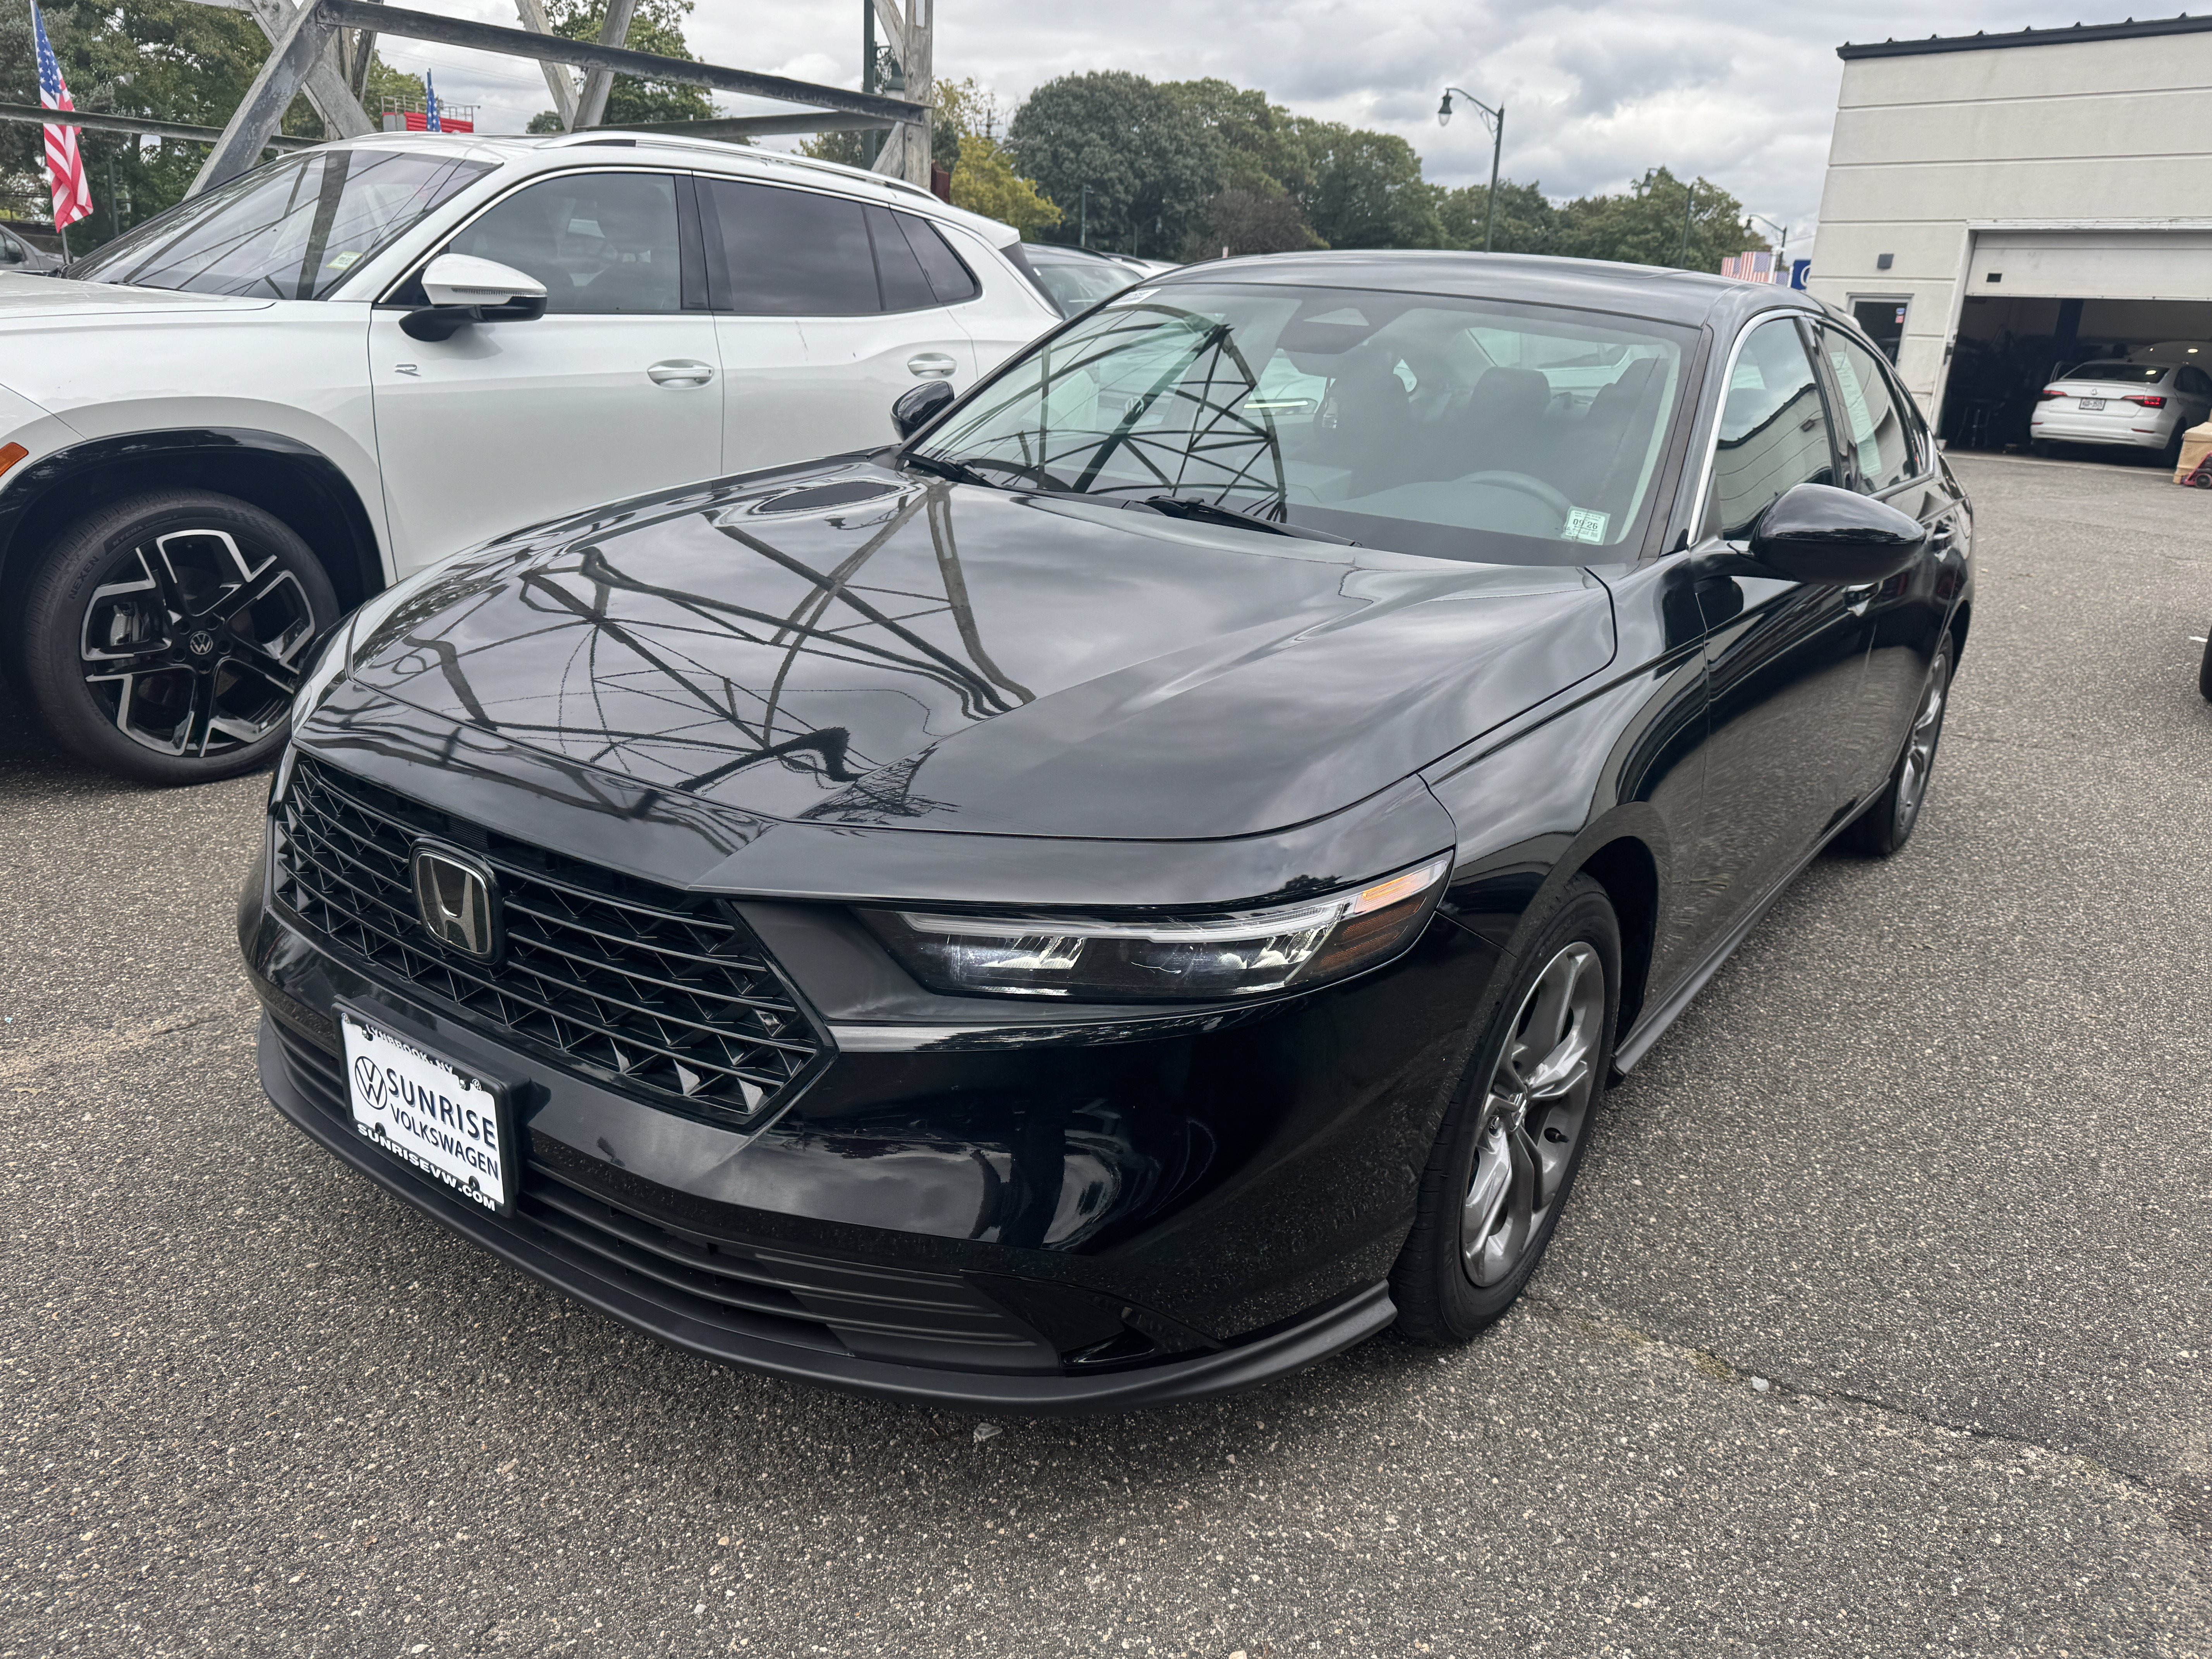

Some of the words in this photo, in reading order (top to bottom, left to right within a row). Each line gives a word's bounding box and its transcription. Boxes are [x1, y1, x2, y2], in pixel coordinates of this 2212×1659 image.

[1587, 521, 1598, 529] 26
[68, 556, 99, 599] NEXEN
[435, 1060, 453, 1075] NY
[386, 1068, 497, 1152] SUNRISE
[357, 1123, 495, 1211] SUNRISEVW.COM
[390, 1103, 499, 1180] VOLKSWAGEN
